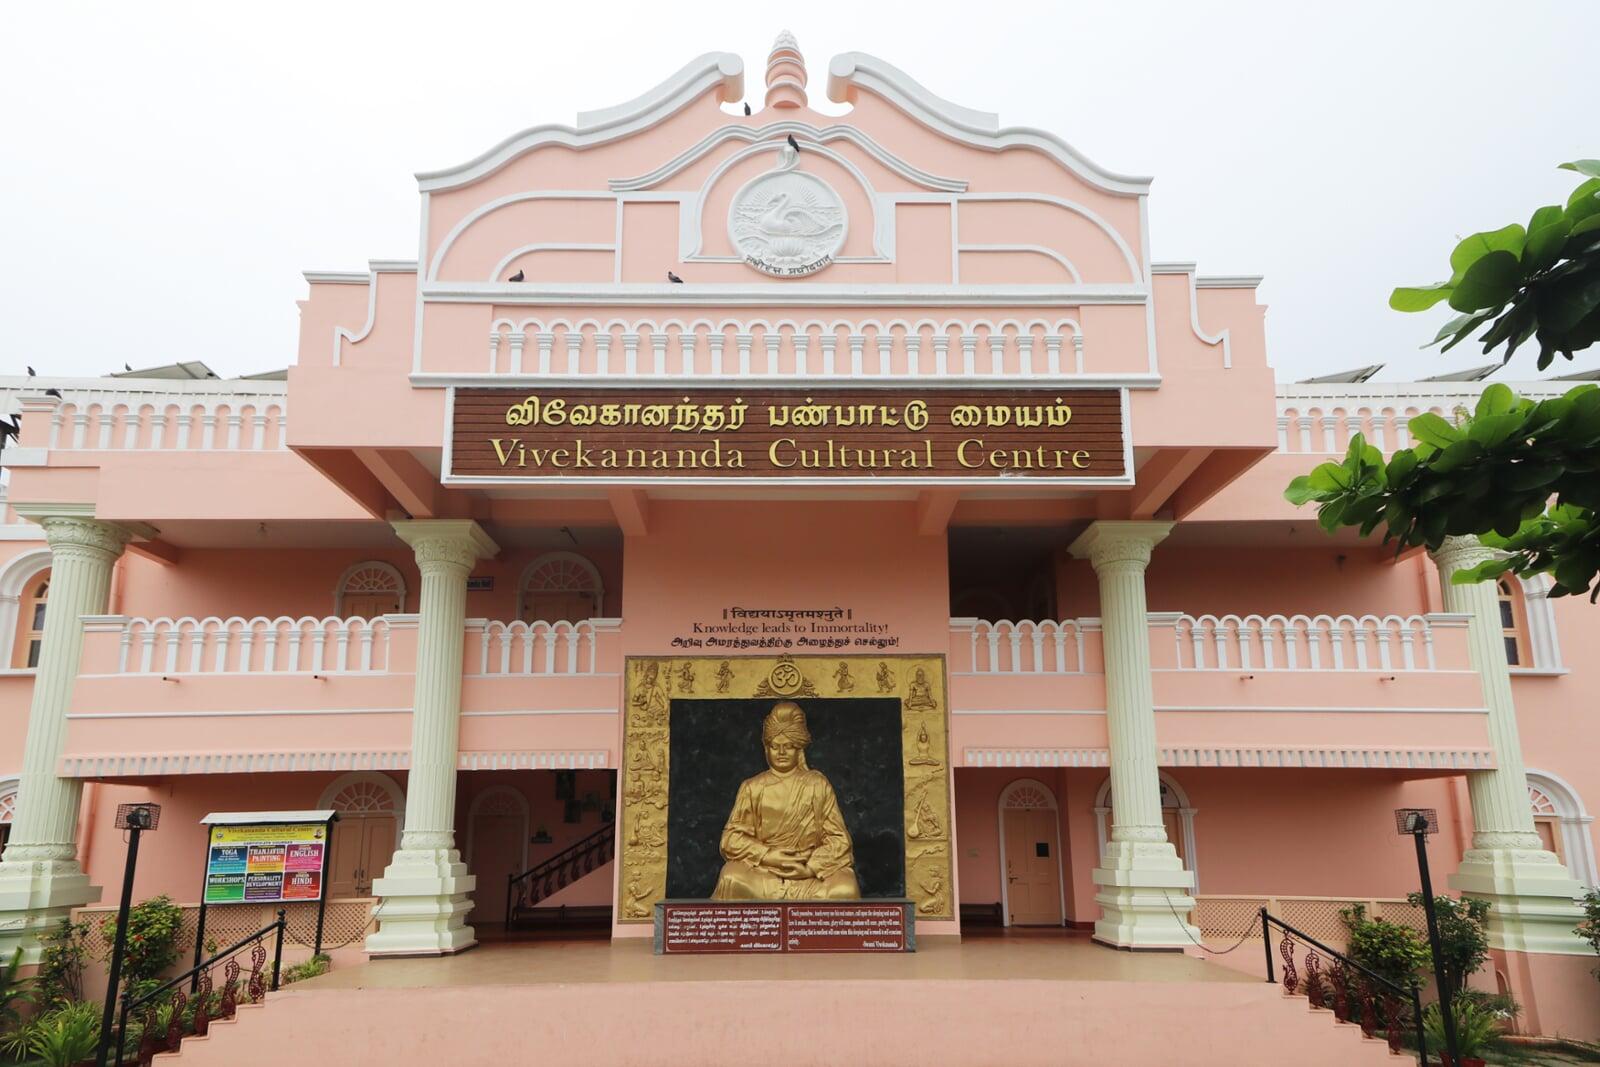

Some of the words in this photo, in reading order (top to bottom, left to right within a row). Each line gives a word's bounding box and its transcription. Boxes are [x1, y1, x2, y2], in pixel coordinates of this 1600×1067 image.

[506, 396, 749, 433] விவேகானந்தர்
[768, 397, 929, 431] பண்பாட்டு
[950, 397, 1073, 428] மையம்
[488, 438, 746, 468] Vivekananda
[769, 438, 935, 469] Cultural
[956, 438, 1092, 469] Centre
[693, 622, 758, 635] Knowledge
[762, 622, 791, 633] leads
[794, 623, 806, 633] to
[811, 622, 889, 635] Immortality!
[670, 637, 702, 648] அறிவு
[209, 876, 245, 884] WORKSHOPS
[291, 877, 313, 885] HINDI
